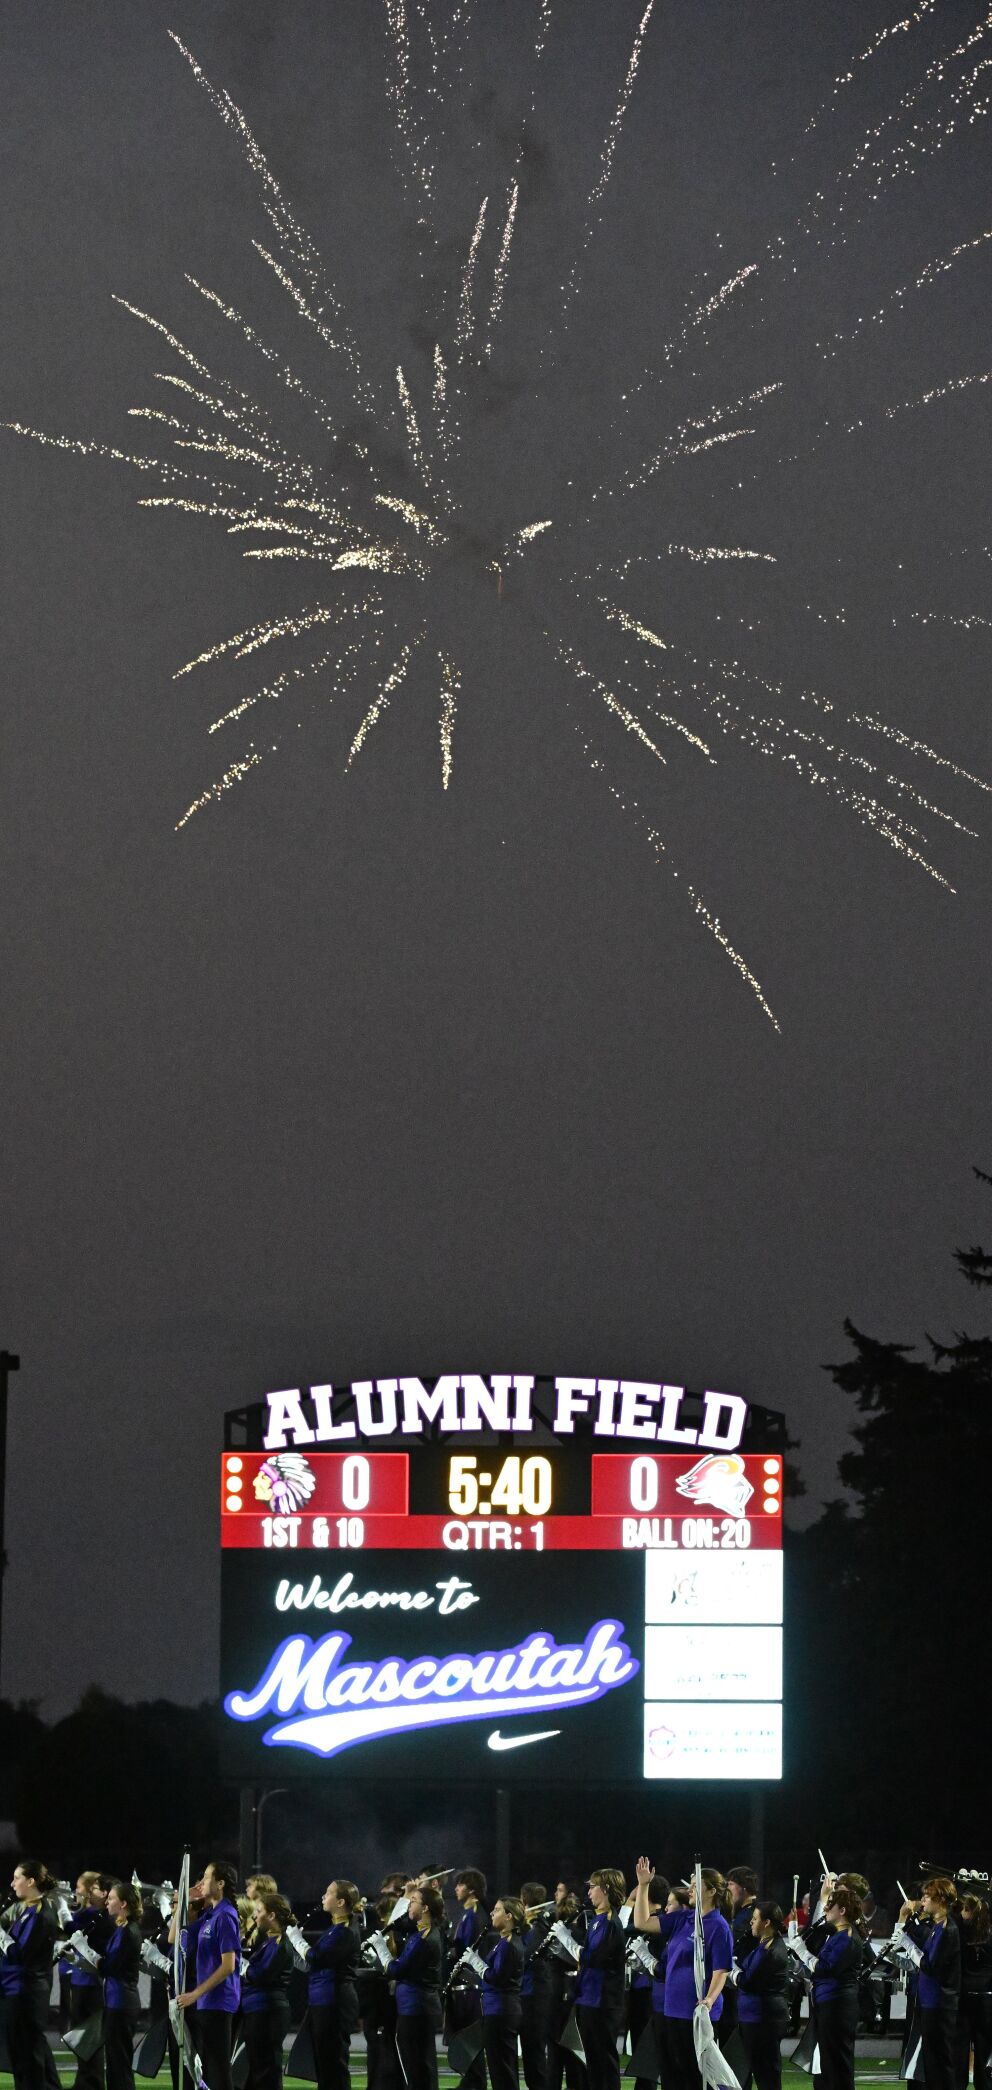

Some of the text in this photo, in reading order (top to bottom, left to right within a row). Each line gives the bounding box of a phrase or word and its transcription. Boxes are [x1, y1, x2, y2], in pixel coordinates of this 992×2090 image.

[263, 1375, 748, 1451] ALUMNI FIELD
[342, 1456, 370, 1510] 0
[448, 1456, 552, 1516] 5:40
[630, 1457, 658, 1511] 0
[262, 1518, 364, 1548] 1ST & 10
[442, 1521, 545, 1550] QTR: 1
[622, 1518, 751, 1549] BALL ON:20
[275, 1573, 480, 1615] Welcome to
[228, 1621, 636, 1719] Mascoutah
